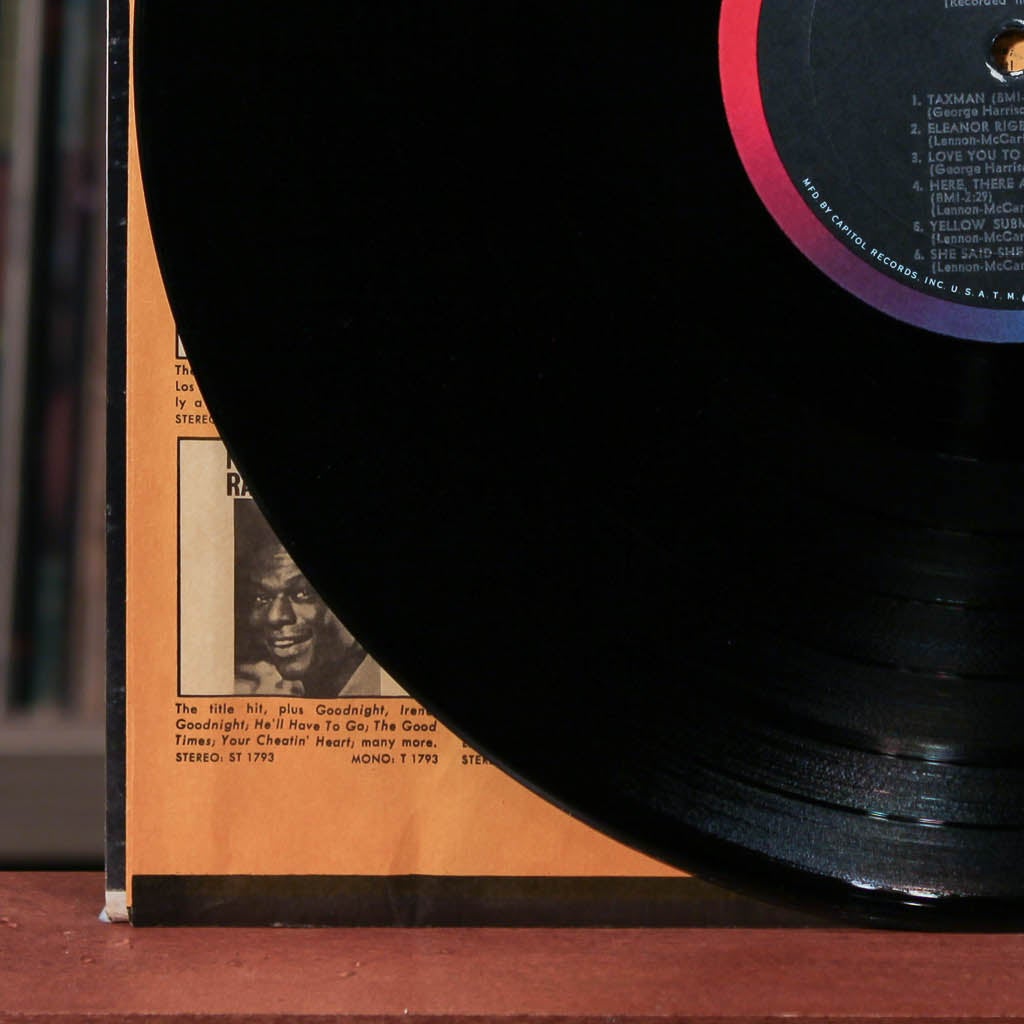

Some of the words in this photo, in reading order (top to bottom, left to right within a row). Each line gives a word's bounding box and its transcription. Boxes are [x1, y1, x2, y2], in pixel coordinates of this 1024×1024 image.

[928, 94, 985, 104] TAXMAN
[928, 106, 979, 119] (George
[910, 123, 921, 135] 2.
[928, 122, 989, 133] ELEANOR
[911, 153, 922, 164] 3.
[928, 150, 962, 162] LOVE
[967, 149, 996, 161] YOU
[1001, 149, 1020, 160] TO
[929, 162, 980, 177] (George
[912, 181, 924, 192] 4.
[930, 178, 969, 192] HERE,
[973, 178, 1014, 189] THERE
[930, 191, 993, 204] (BMI-2:29)
[819, 201, 833, 214] BY
[831, 215, 867, 251] CAPITOL
[930, 219, 985, 231] YELLOW
[913, 250, 925, 261] 6.
[930, 249, 957, 260] SHE
[961, 248, 993, 259] SAID
[176, 381, 194, 392] Los
[176, 397, 186, 410] ly
[175, 703, 198, 714] The
[209, 703, 235, 714] title
[247, 703, 267, 716] hit,
[279, 704, 304, 716] plus
[315, 704, 389, 718] Goodnight,
[176, 719, 249, 733] Goodnight;
[255, 719, 284, 730] He'll
[289, 720, 321, 732] Have
[326, 721, 341, 732] To
[346, 721, 369, 733] Go;
[374, 721, 397, 731] The
[402, 720, 437, 732] Good
[176, 735, 216, 747] Times;
[222, 735, 250, 746] Your
[257, 734, 310, 746] Cheatin'
[316, 736, 355, 749] Heart;
[361, 739, 396, 750] many
[402, 737, 438, 748] more.
[175, 752, 223, 762] STEREO:
[229, 753, 242, 762] ST
[247, 753, 275, 762] 1793
[351, 754, 395, 764] MONO:
[400, 754, 407, 764] T
[412, 754, 438, 764] 1793
